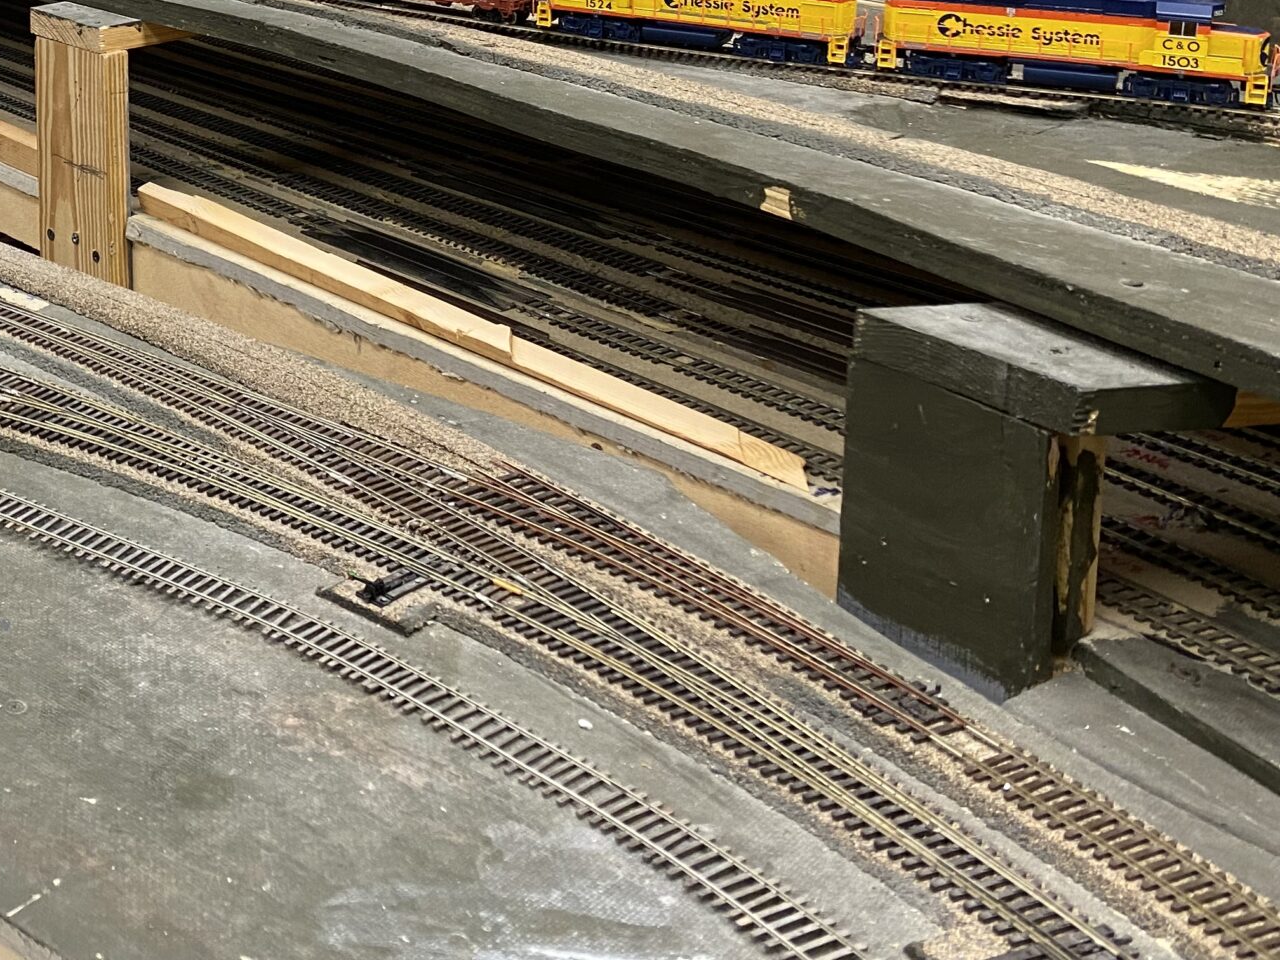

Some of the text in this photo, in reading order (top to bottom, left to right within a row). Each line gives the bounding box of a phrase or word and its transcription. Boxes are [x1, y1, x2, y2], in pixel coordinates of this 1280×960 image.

[742, 0, 800, 19] System
[937, 13, 1100, 46] Chessie System
[1161, 55, 1199, 69] 1503
